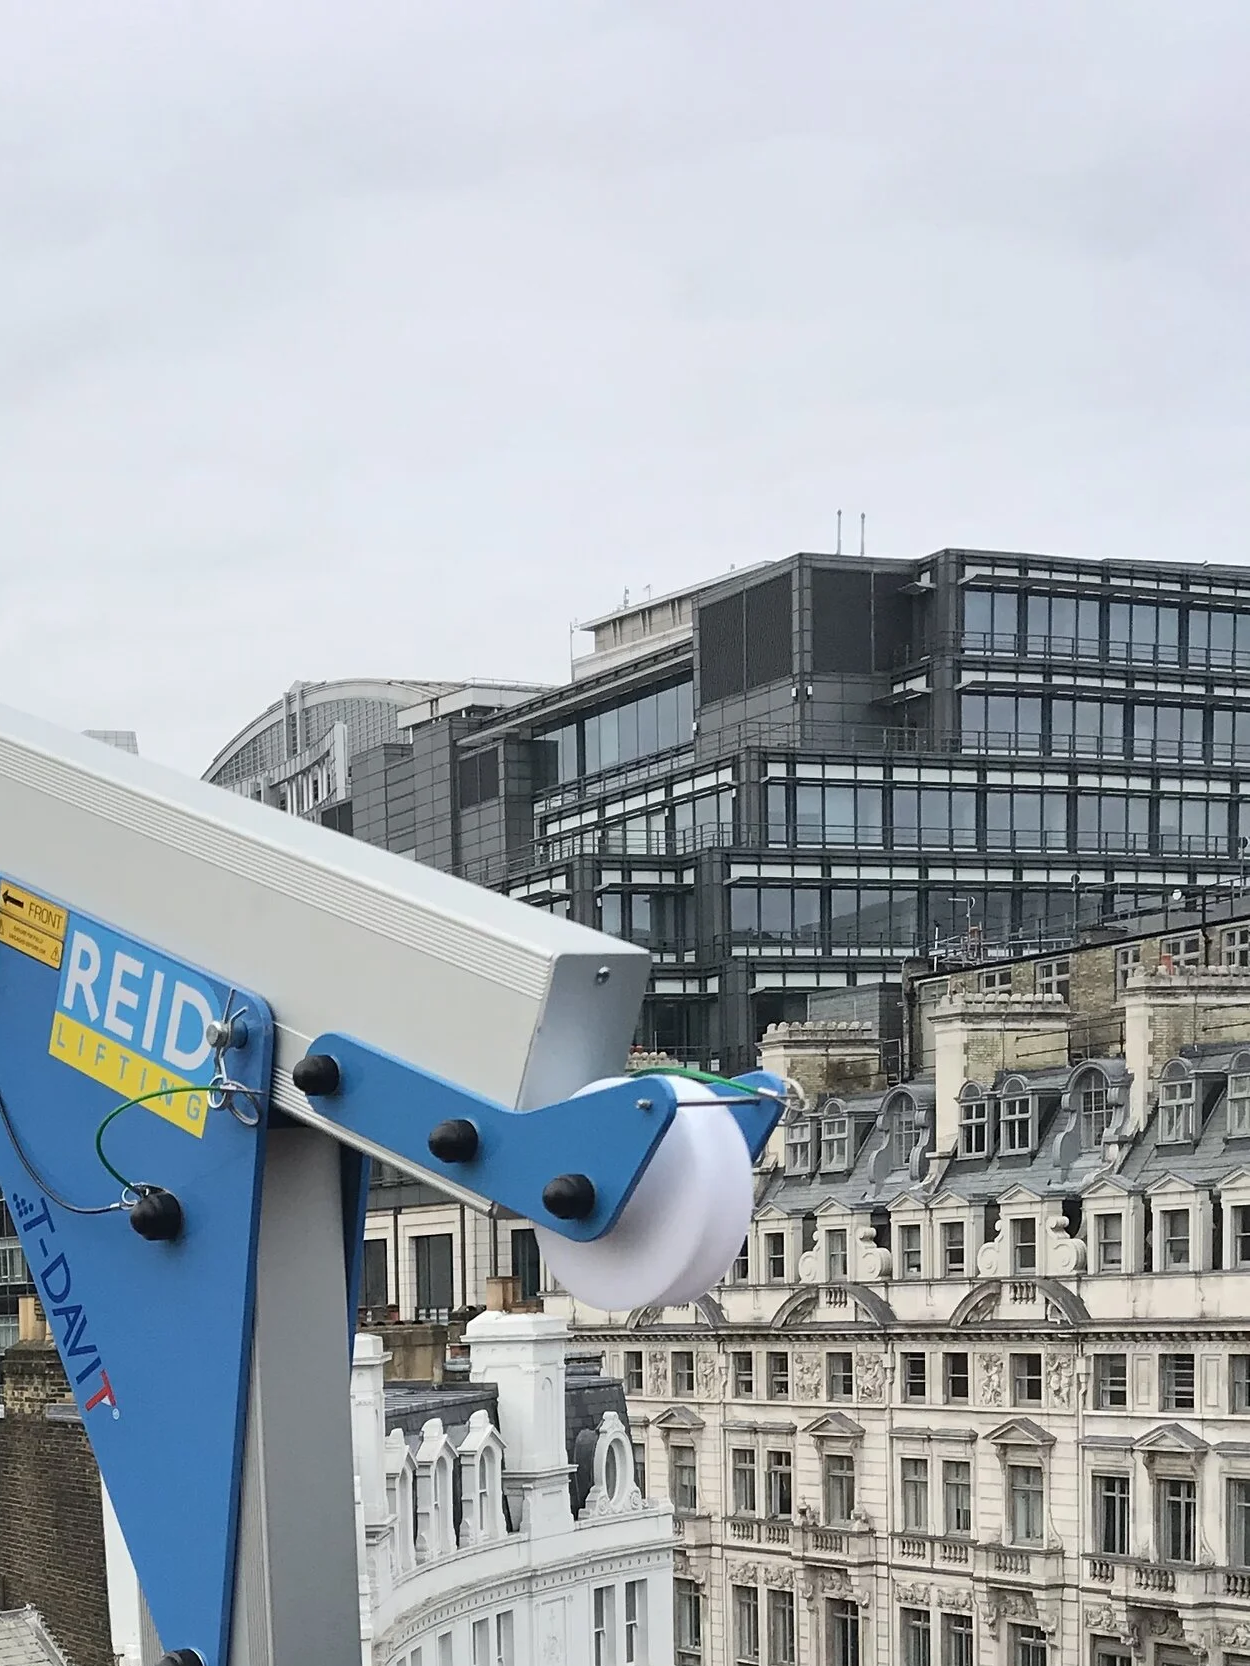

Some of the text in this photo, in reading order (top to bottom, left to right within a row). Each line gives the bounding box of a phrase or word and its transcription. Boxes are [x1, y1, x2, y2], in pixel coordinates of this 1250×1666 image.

[28, 902, 63, 930] FRONT
[63, 930, 214, 1071] REID
[56, 1022, 202, 1121] LIFTING
